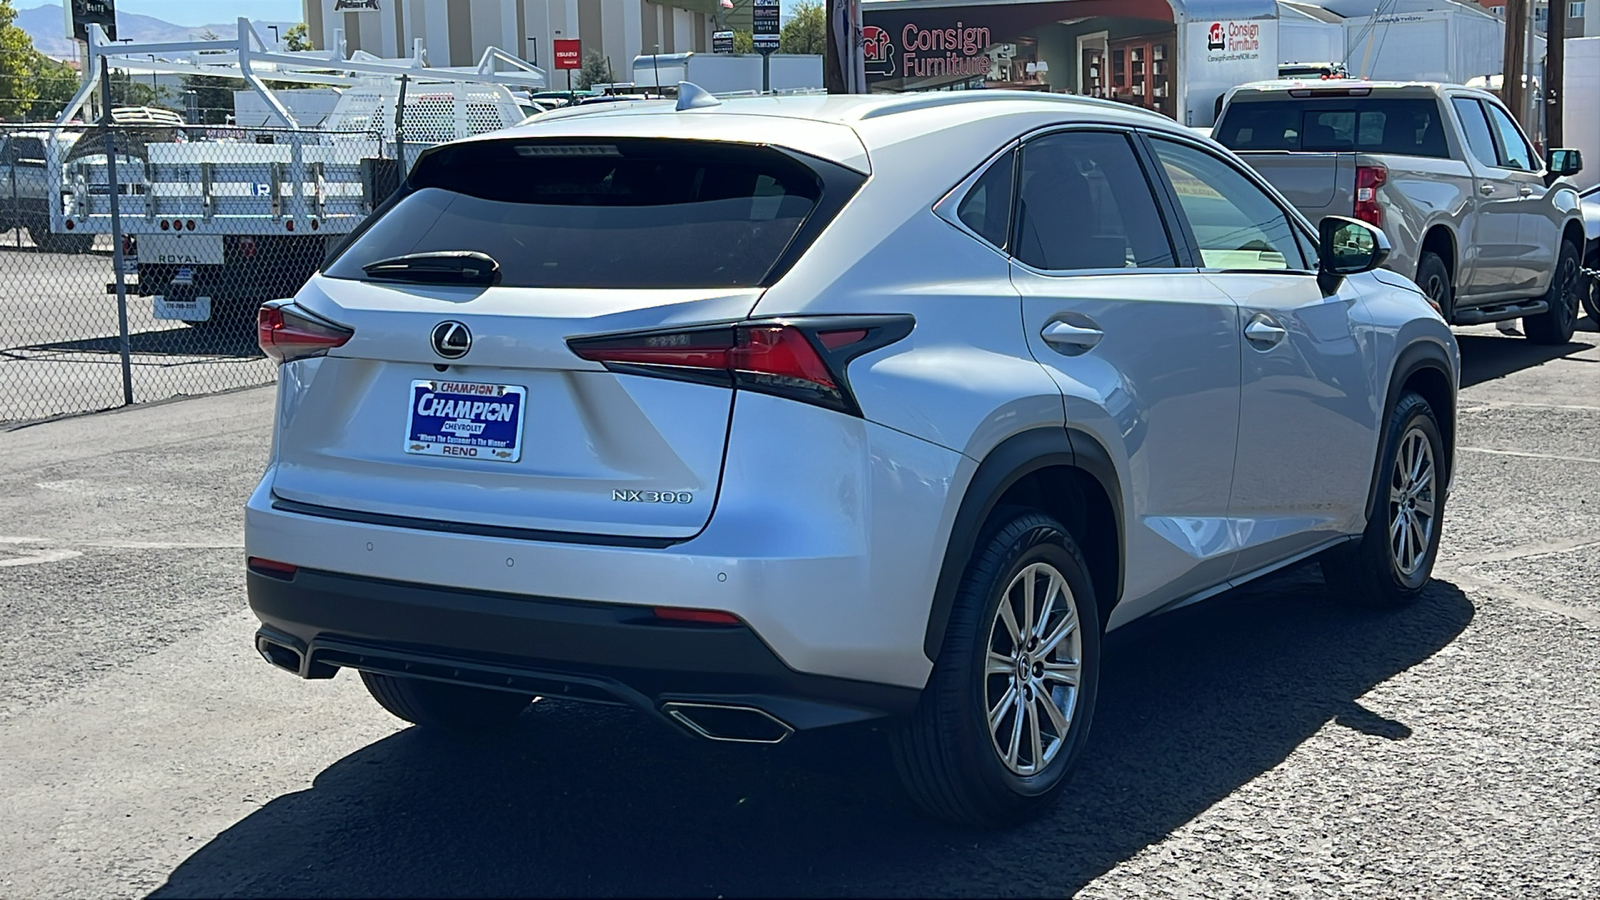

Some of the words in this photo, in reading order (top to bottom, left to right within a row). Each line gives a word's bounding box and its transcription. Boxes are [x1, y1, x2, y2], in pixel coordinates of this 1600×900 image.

[1228, 21, 1259, 39] Consign
[902, 22, 990, 55] Consign
[1228, 38, 1259, 52] Furniture
[903, 52, 992, 77] Furniture
[158, 254, 201, 263] ROYAL
[440, 382, 494, 395] CHAMPION
[417, 393, 515, 422] CHAMPION
[444, 422, 482, 432] CHEVROLET
[437, 434, 446, 443] The
[477, 438, 487, 446] The
[443, 446, 478, 456] RENO
